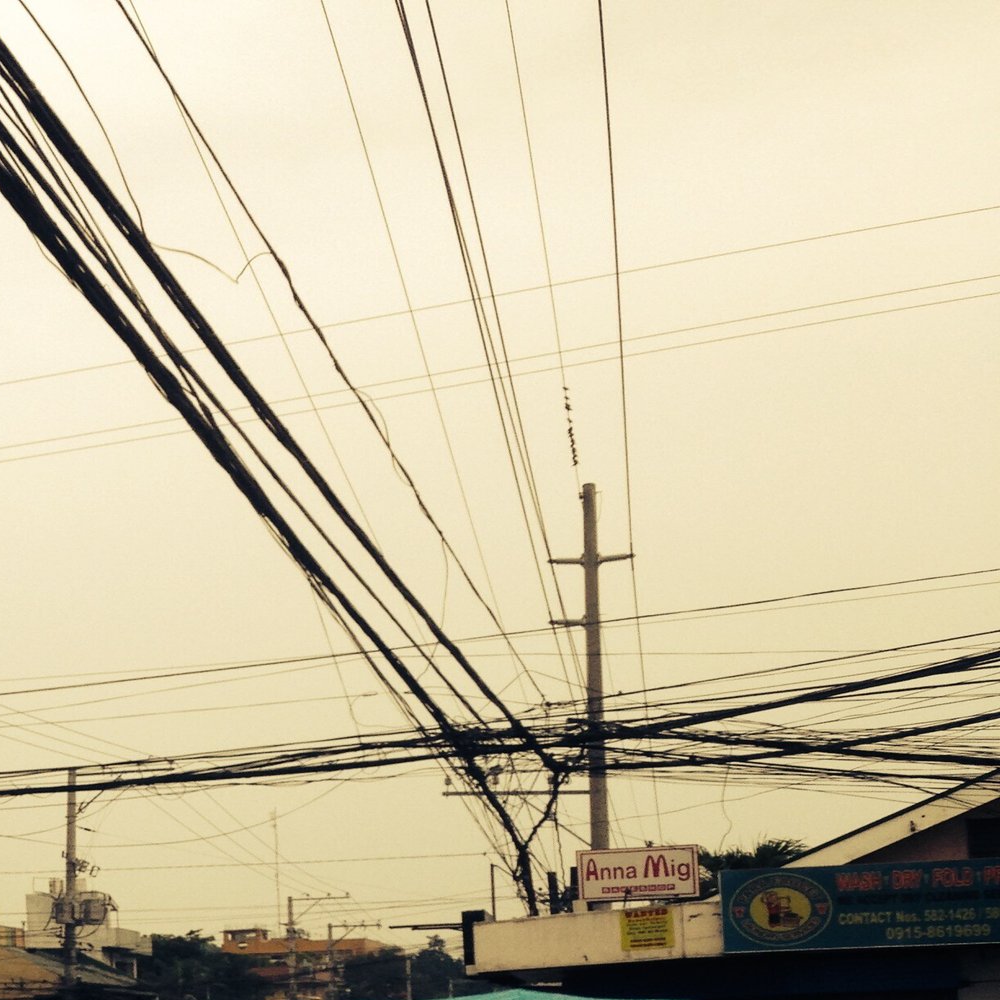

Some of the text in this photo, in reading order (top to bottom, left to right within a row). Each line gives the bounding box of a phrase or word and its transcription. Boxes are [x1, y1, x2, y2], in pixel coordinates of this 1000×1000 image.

[586, 854, 690, 881] Anna Mig
[838, 911, 892, 925] CONTACT
